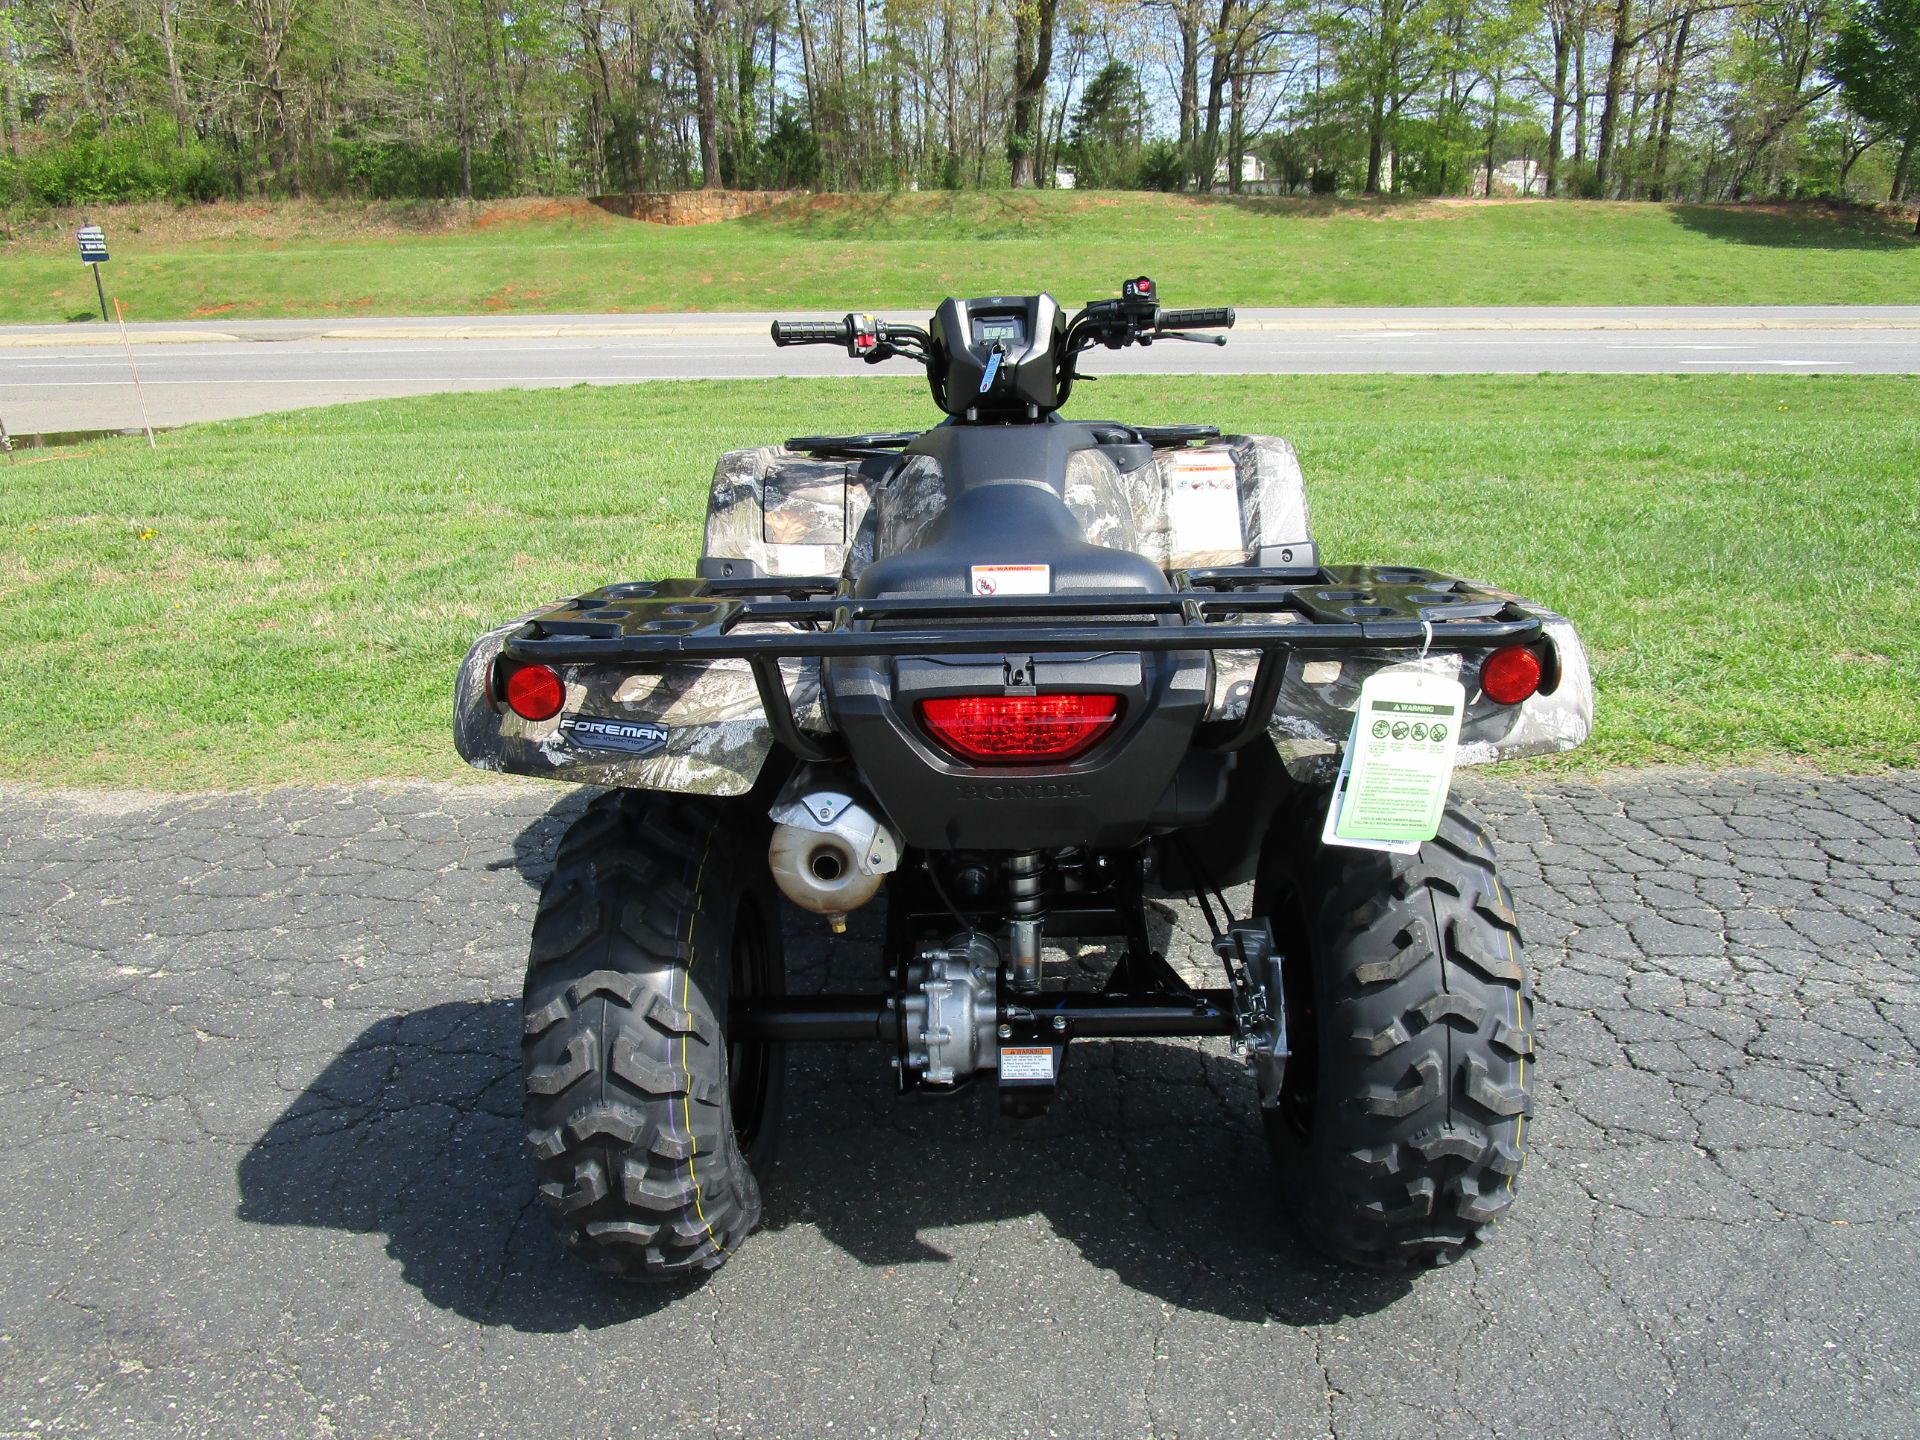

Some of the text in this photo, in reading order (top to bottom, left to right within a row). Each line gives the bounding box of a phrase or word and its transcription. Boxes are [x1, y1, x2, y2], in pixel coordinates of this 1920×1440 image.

[1401, 704, 1434, 713] WARNING
[560, 720, 668, 742] FOREMAN
[956, 784, 1091, 800] HONDA
